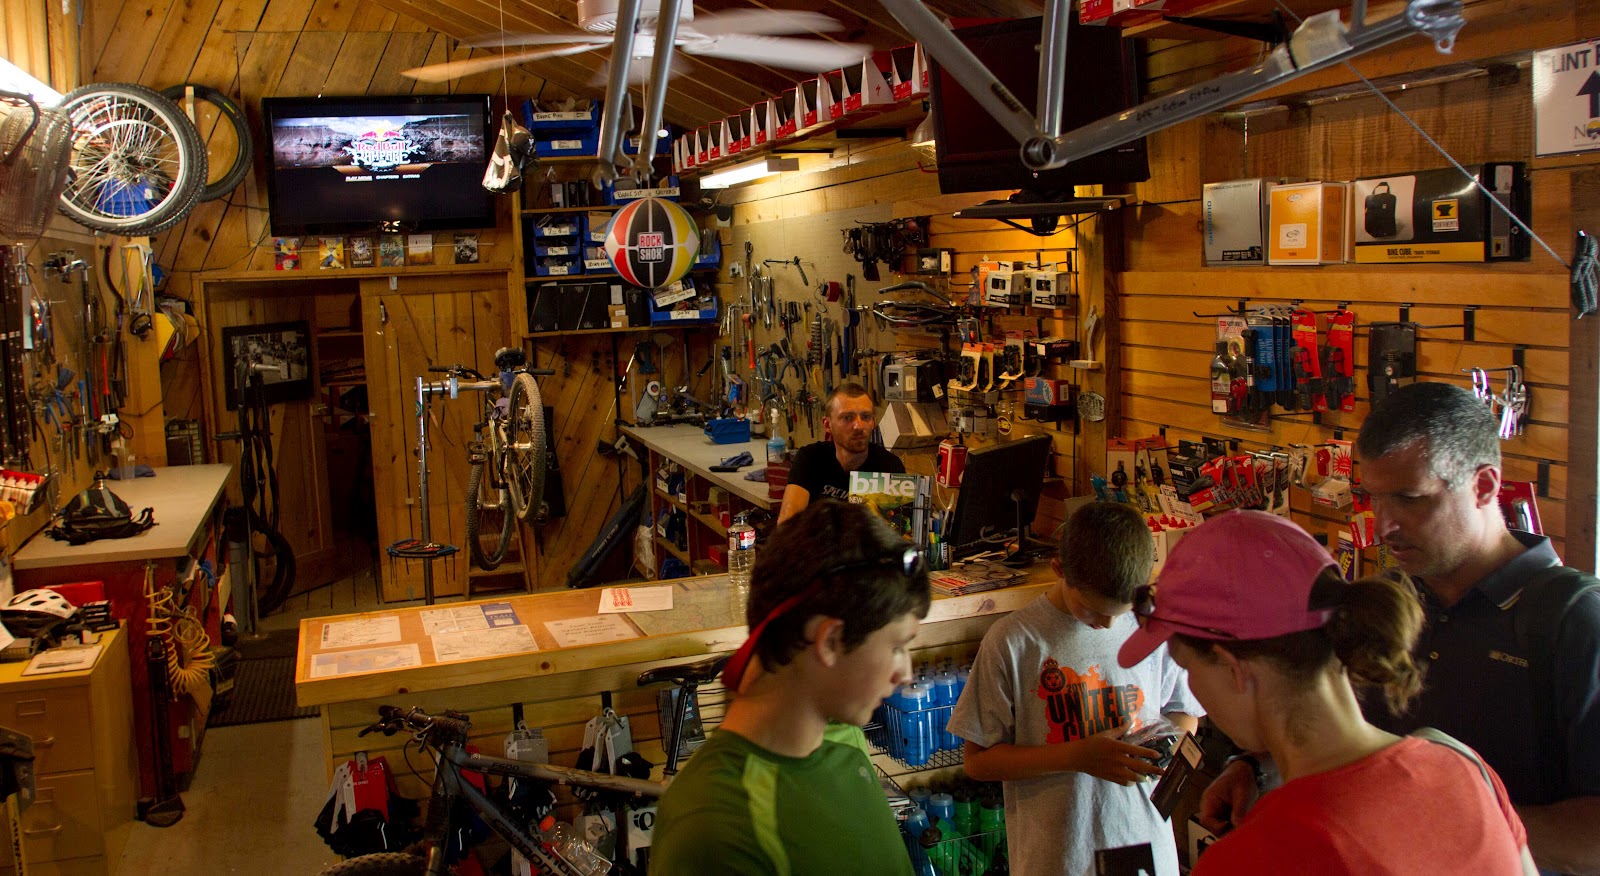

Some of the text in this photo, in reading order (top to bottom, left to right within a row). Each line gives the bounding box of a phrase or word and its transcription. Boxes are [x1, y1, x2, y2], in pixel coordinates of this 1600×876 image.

[357, 141, 405, 151] Red Bull
[351, 151, 411, 166] RAMPAGE
[639, 235, 662, 247] ROCK
[639, 248, 662, 260] SHOX
[850, 470, 914, 496] bike
[1047, 685, 1130, 724] UNITED
[1126, 684, 1139, 713] CUP
